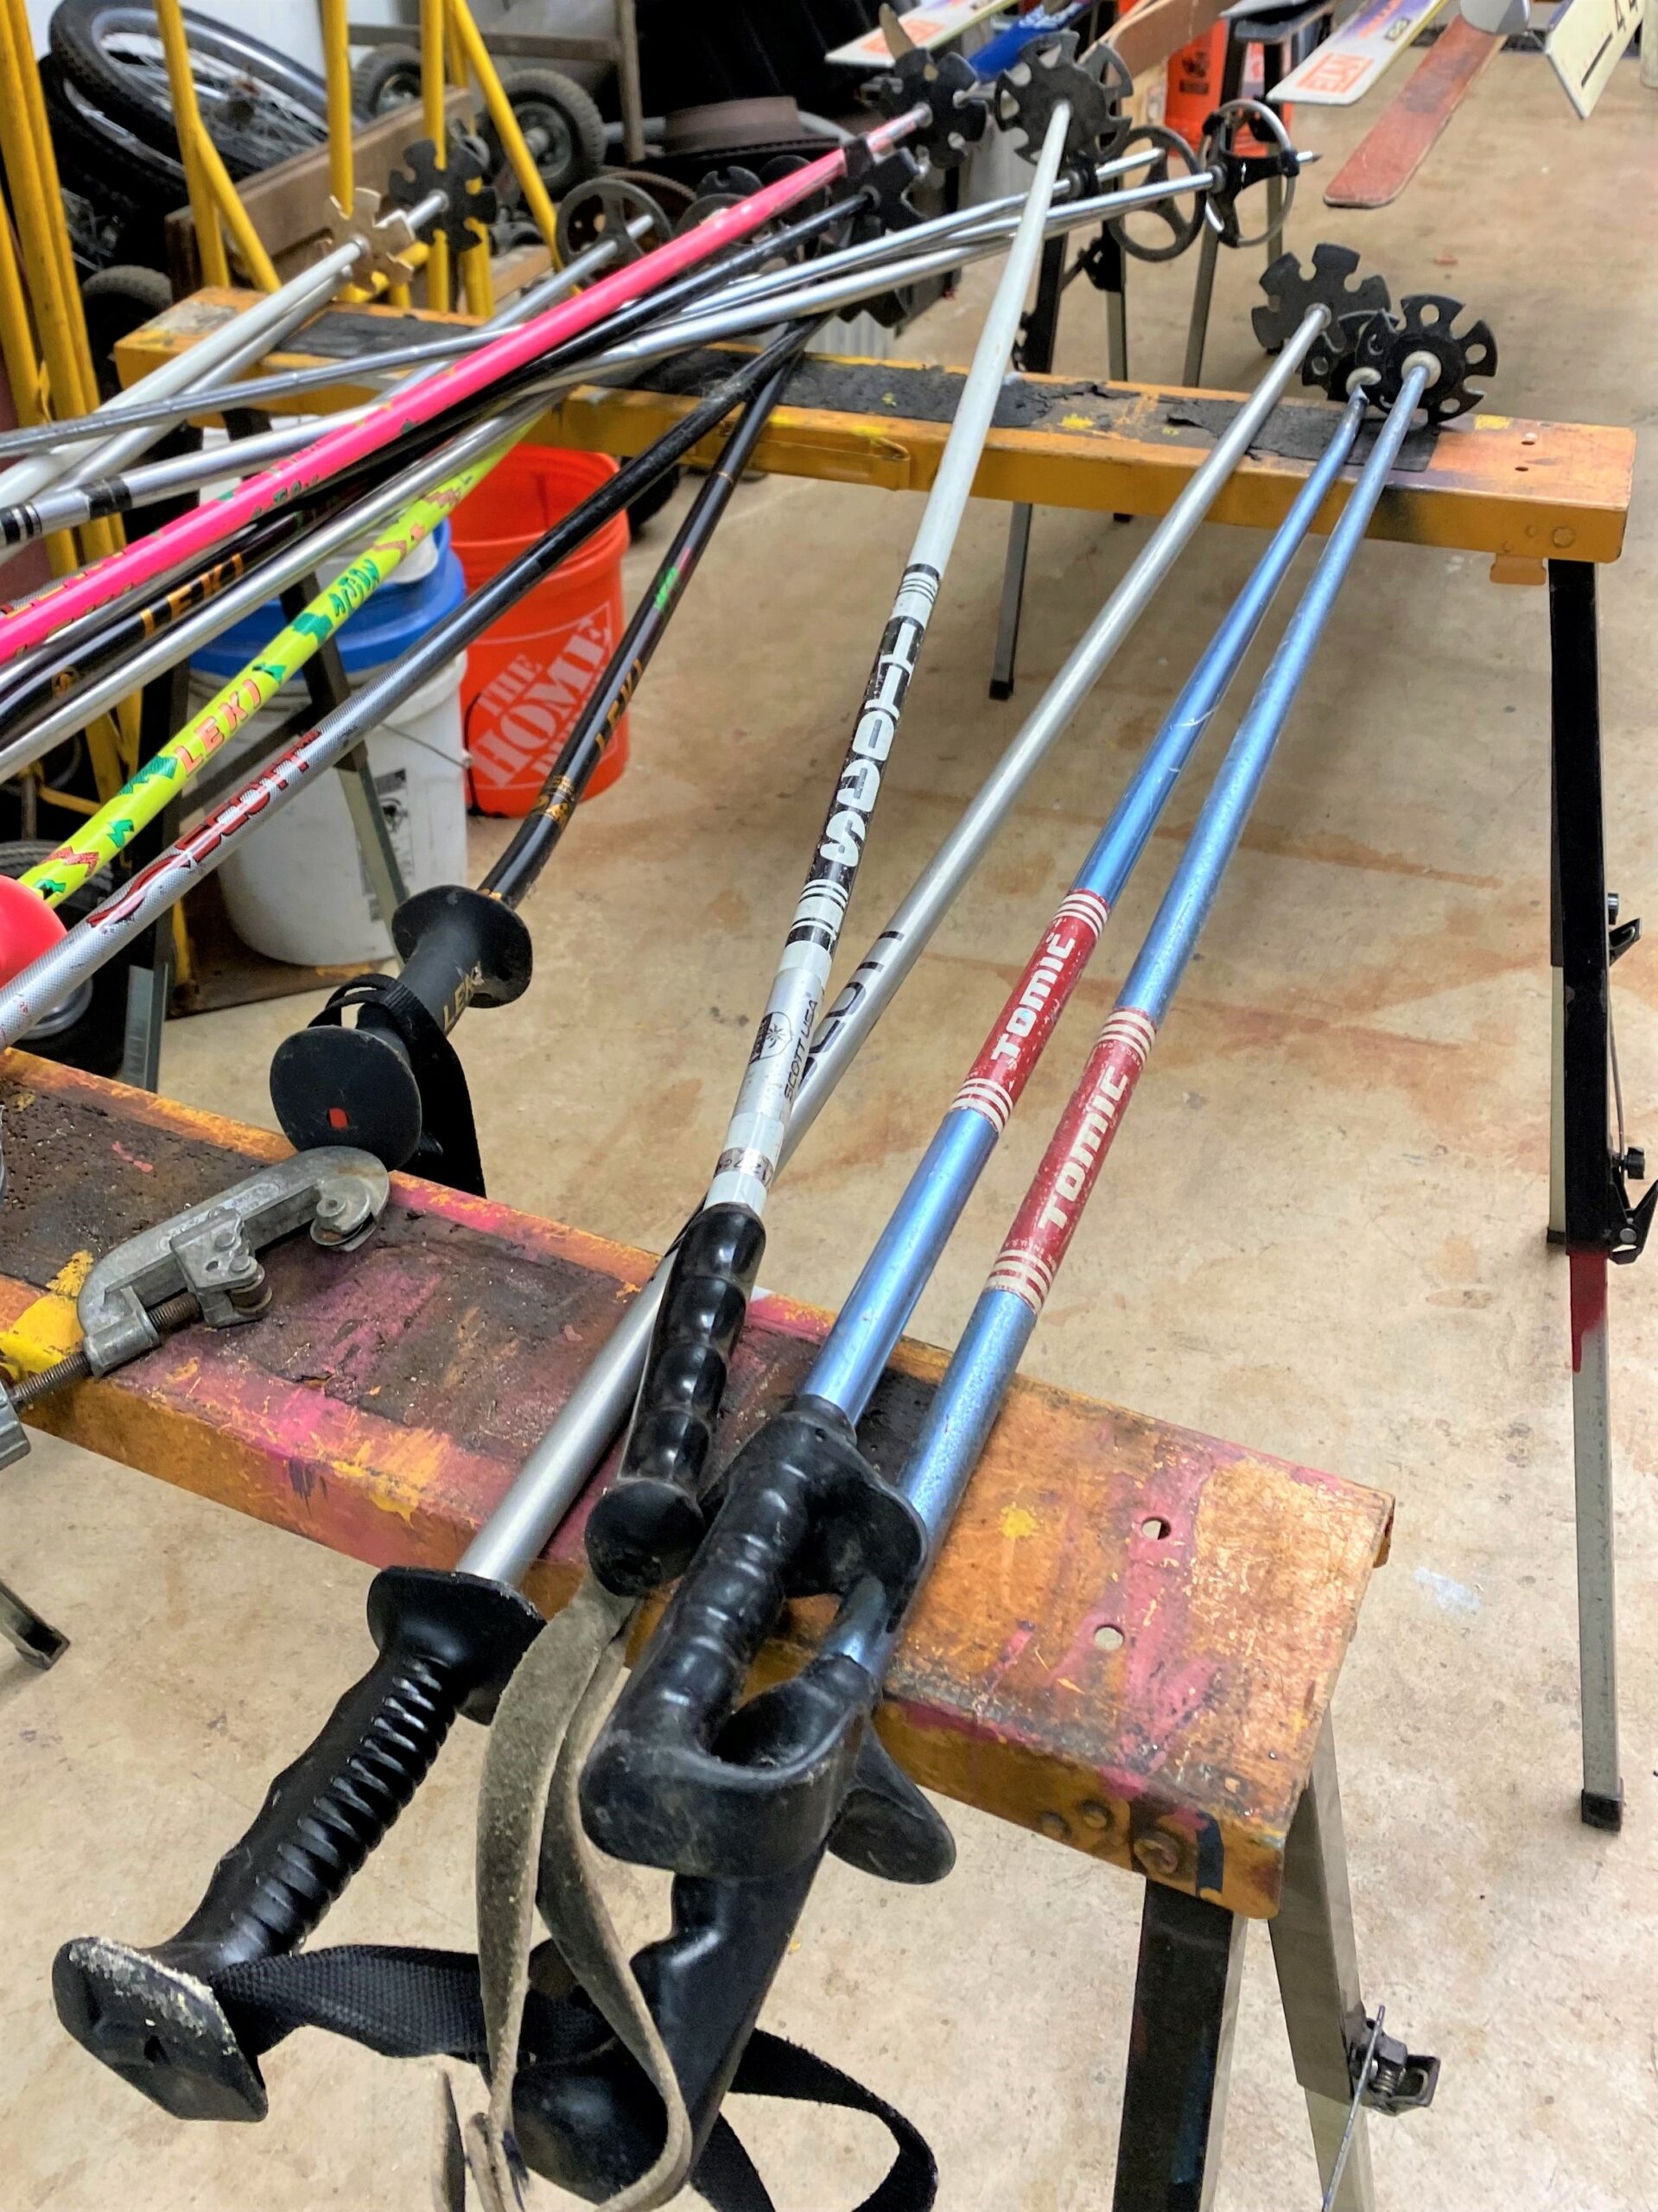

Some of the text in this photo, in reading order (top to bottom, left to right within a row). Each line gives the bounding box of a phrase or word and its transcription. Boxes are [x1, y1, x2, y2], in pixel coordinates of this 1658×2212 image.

[175, 678, 263, 775] LEKI
[467, 614, 607, 788] HOME
[476, 652, 543, 717] THE
[819, 621, 917, 868] SCOTT
[175, 745, 313, 863] SCOTT
[784, 999, 817, 1103] SCOTT USA
[1037, 1064, 1130, 1230] TOMIC
